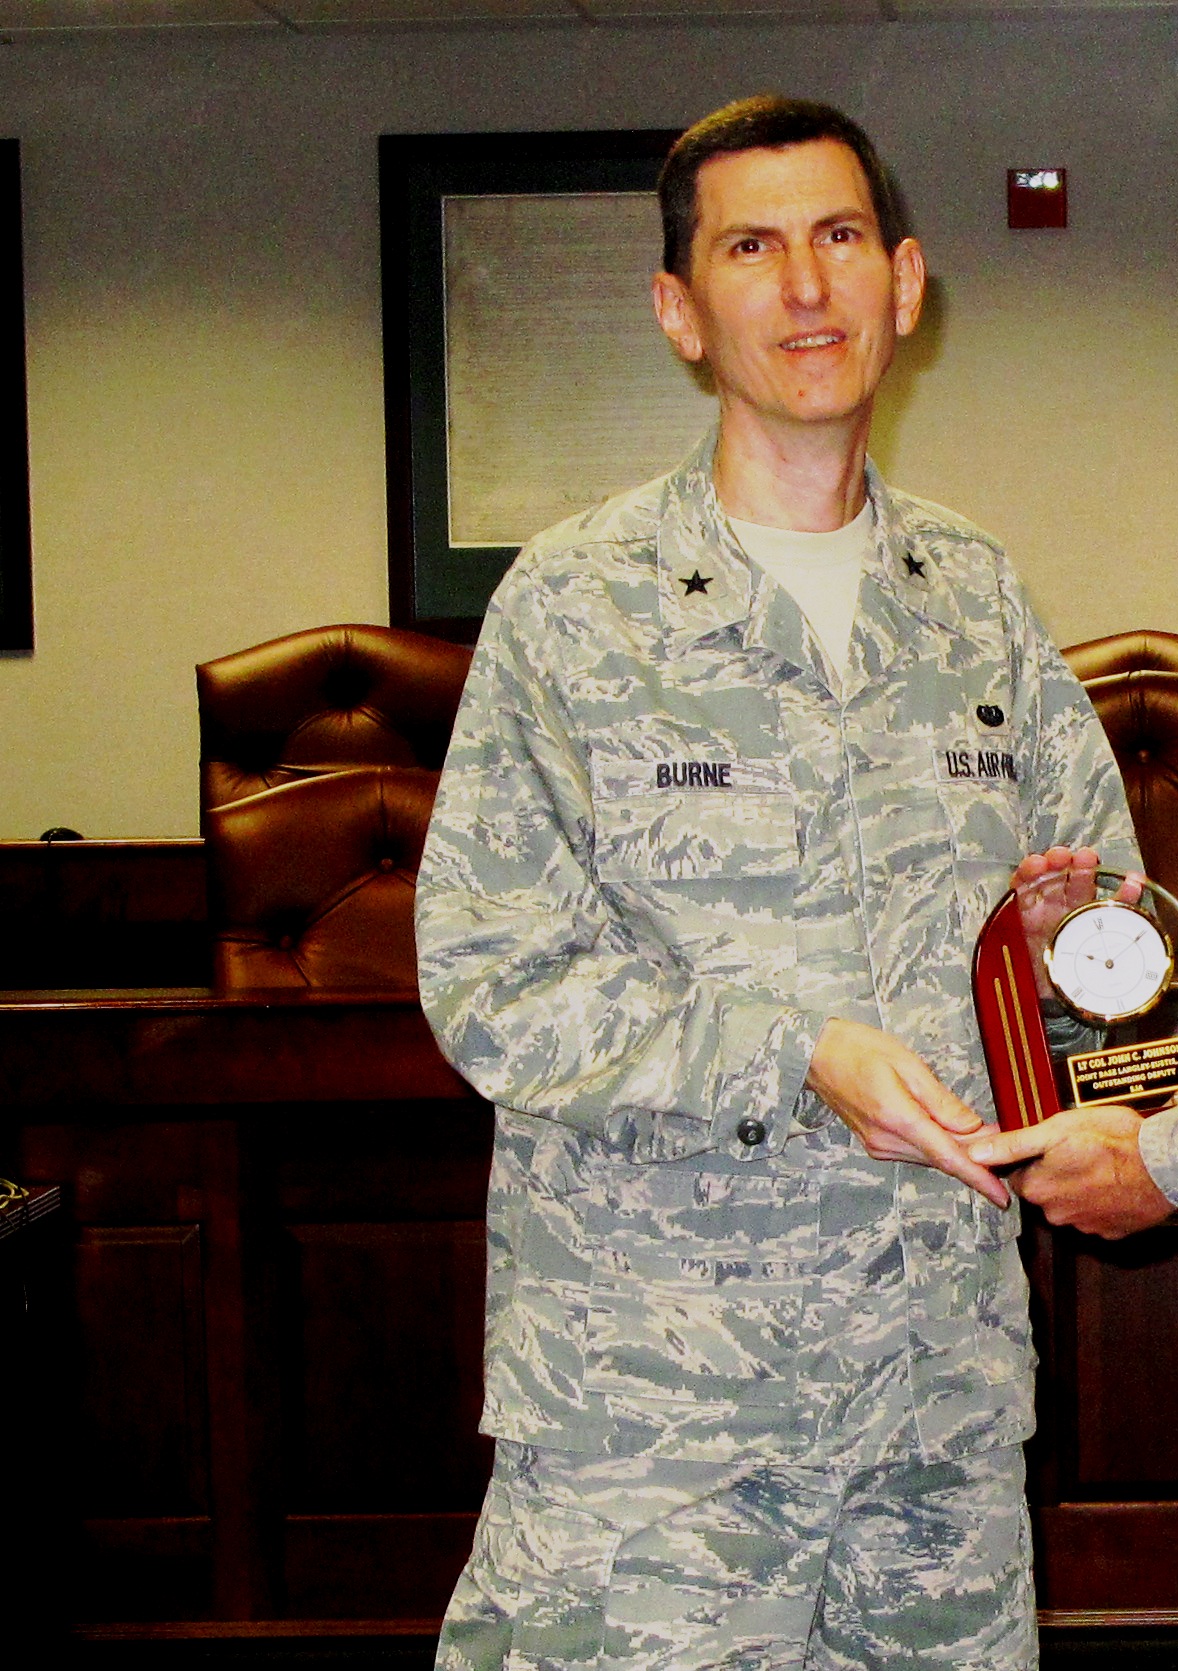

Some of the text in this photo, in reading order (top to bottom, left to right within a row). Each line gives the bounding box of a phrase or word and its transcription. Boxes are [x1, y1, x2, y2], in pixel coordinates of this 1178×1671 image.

[656, 761, 733, 788] BURNE
[946, 751, 975, 777] U.S.
[977, 751, 1001, 778] AIR
[1077, 1060, 1088, 1072] LT
[1088, 1057, 1107, 1069] COL
[1107, 1052, 1130, 1066] JOHN
[1131, 1051, 1142, 1061] C.
[1076, 1071, 1098, 1083] JOINT
[1098, 1068, 1118, 1079] BASE
[1092, 1068, 1176, 1090] OUTSTANDING DEPUTY
